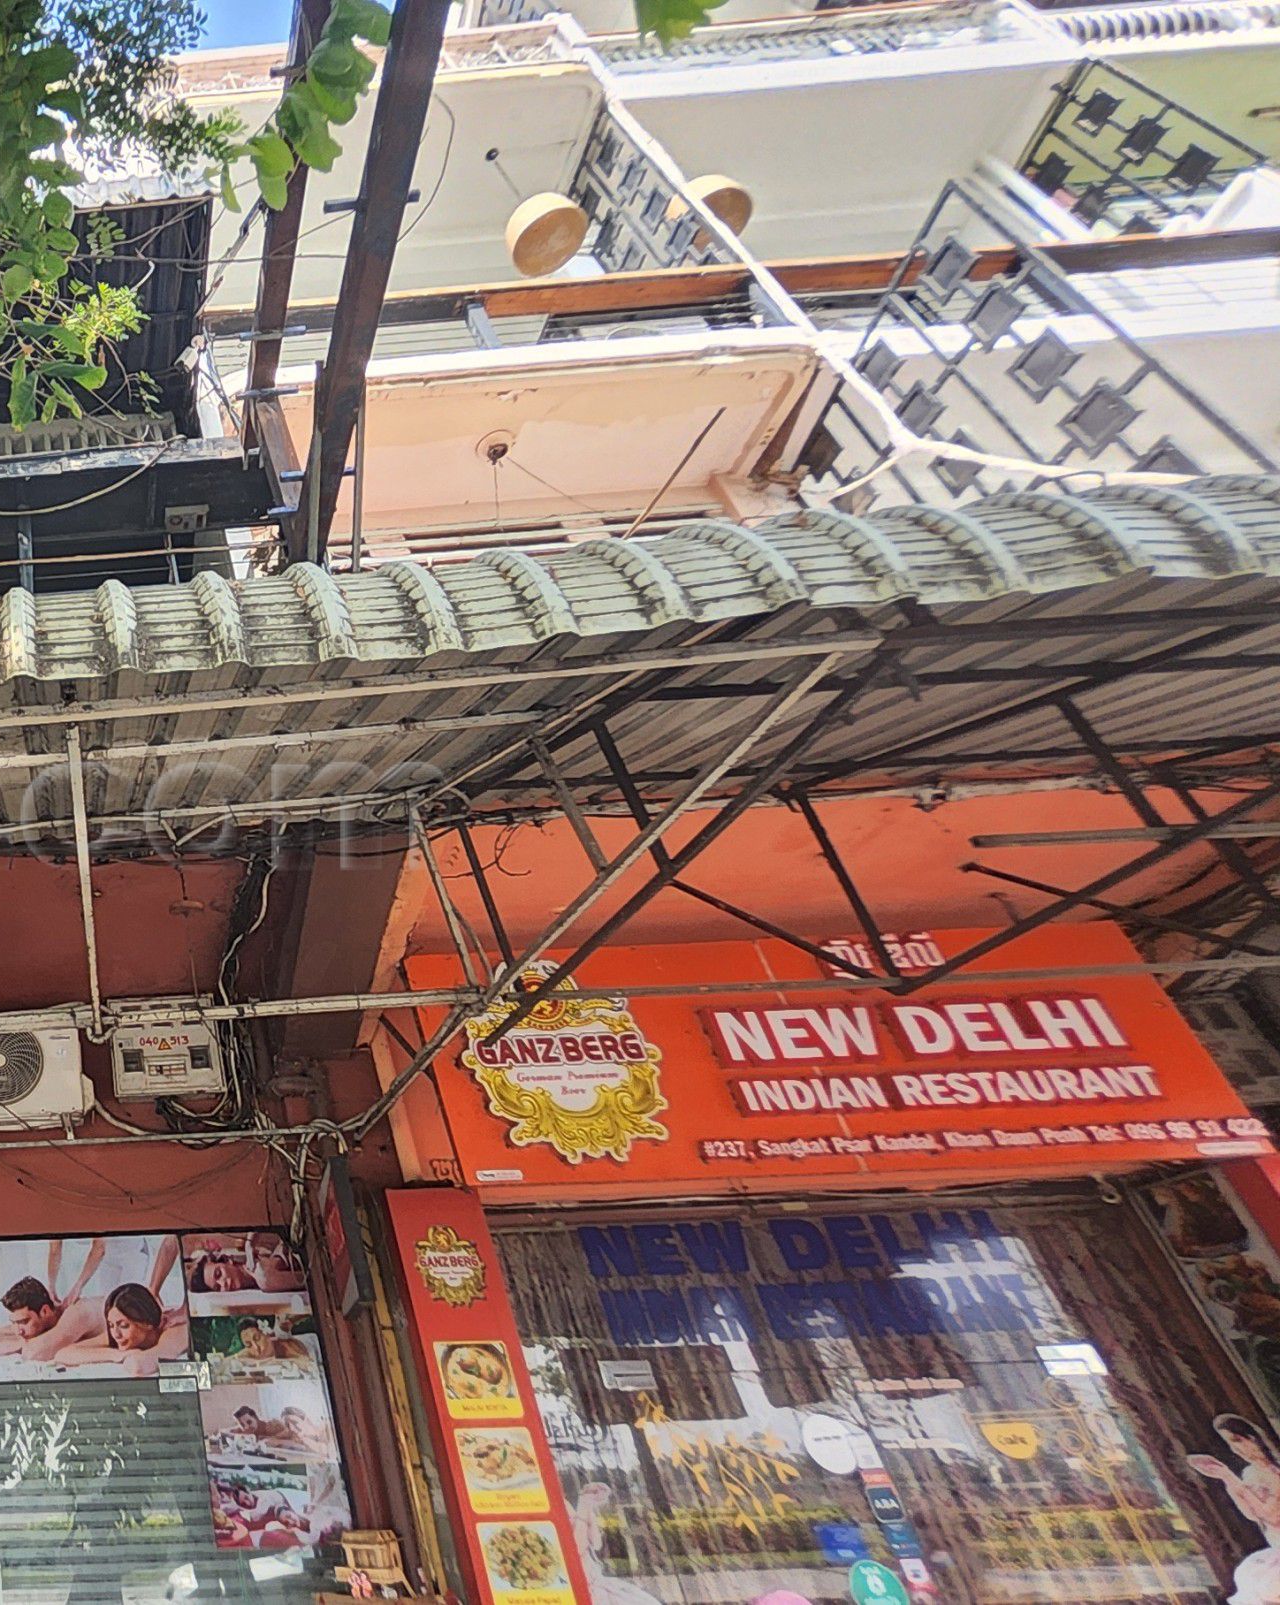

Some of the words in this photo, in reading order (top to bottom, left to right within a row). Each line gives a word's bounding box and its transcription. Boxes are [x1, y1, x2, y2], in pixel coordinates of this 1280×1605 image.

[139, 1036, 159, 1047] 040
[170, 1035, 189, 1045] 513
[713, 1005, 881, 1062] NEW
[892, 997, 1128, 1054] DELHI
[477, 1034, 645, 1065] GANZBERG
[740, 1075, 891, 1112] INDIAN
[893, 1065, 1162, 1107] RESTAURANT
[703, 1140, 755, 1159] #237,
[760, 1138, 831, 1158] Sangkat
[576, 1220, 750, 1278] NEW
[766, 1208, 1017, 1272] DELHI
